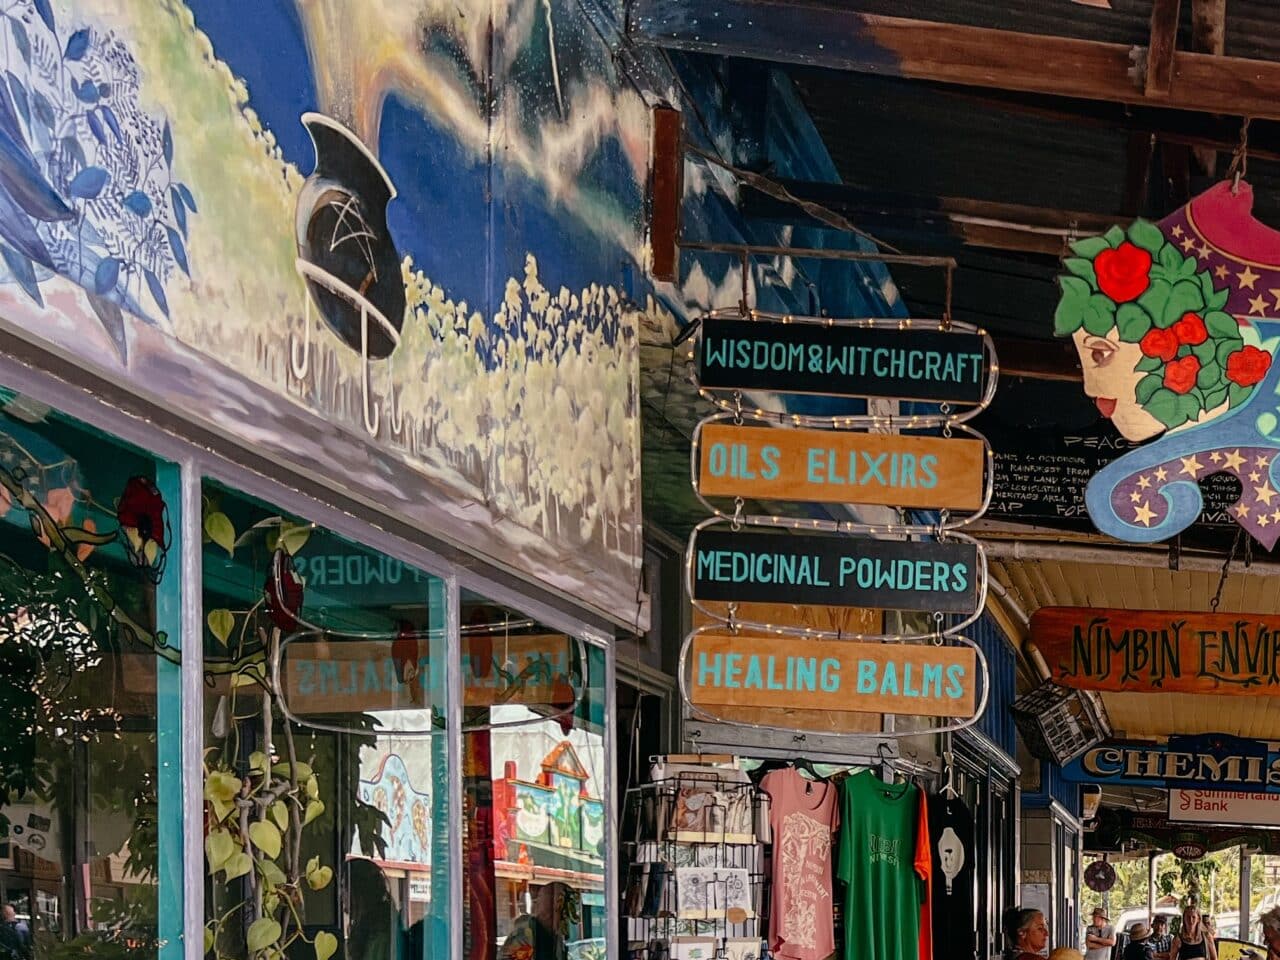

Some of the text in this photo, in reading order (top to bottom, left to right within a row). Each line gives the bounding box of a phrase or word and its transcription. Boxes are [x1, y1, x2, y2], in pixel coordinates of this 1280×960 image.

[705, 338, 983, 384] WISDOM&WITCHCRAFT
[709, 443, 939, 489] OILS ELIXIRS
[697, 550, 969, 592] MEDICINAL POWDERS
[698, 652, 966, 699] HEALING BALMS
[1060, 617, 1186, 688] NIMBIN
[1194, 799, 1229, 811] Bank
